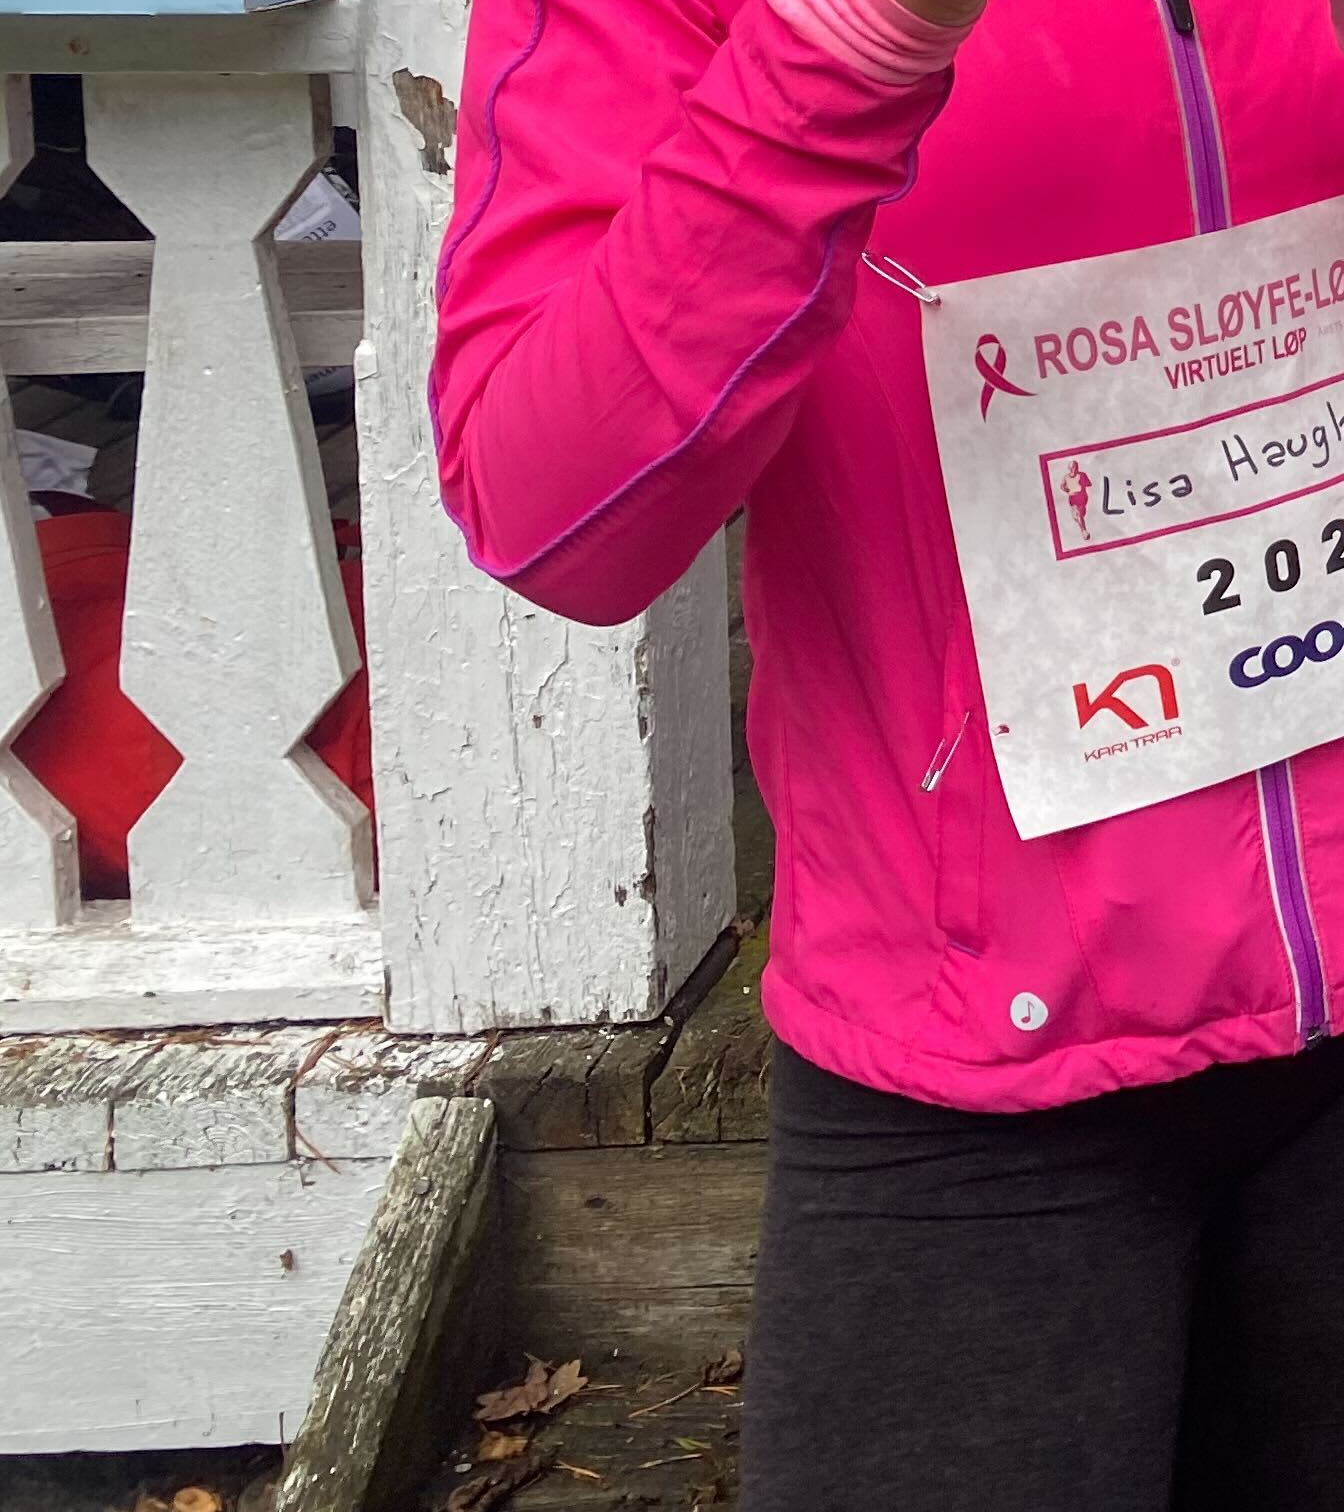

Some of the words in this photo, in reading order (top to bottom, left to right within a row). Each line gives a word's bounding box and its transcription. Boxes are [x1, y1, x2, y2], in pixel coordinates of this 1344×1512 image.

[1034, 316, 1160, 378] ROSA
[1165, 344, 1266, 389] VIRTUELT
[1273, 327, 1307, 363] LØP
[1101, 472, 1194, 516] Lisa
[1084, 742, 1129, 762] KARI
